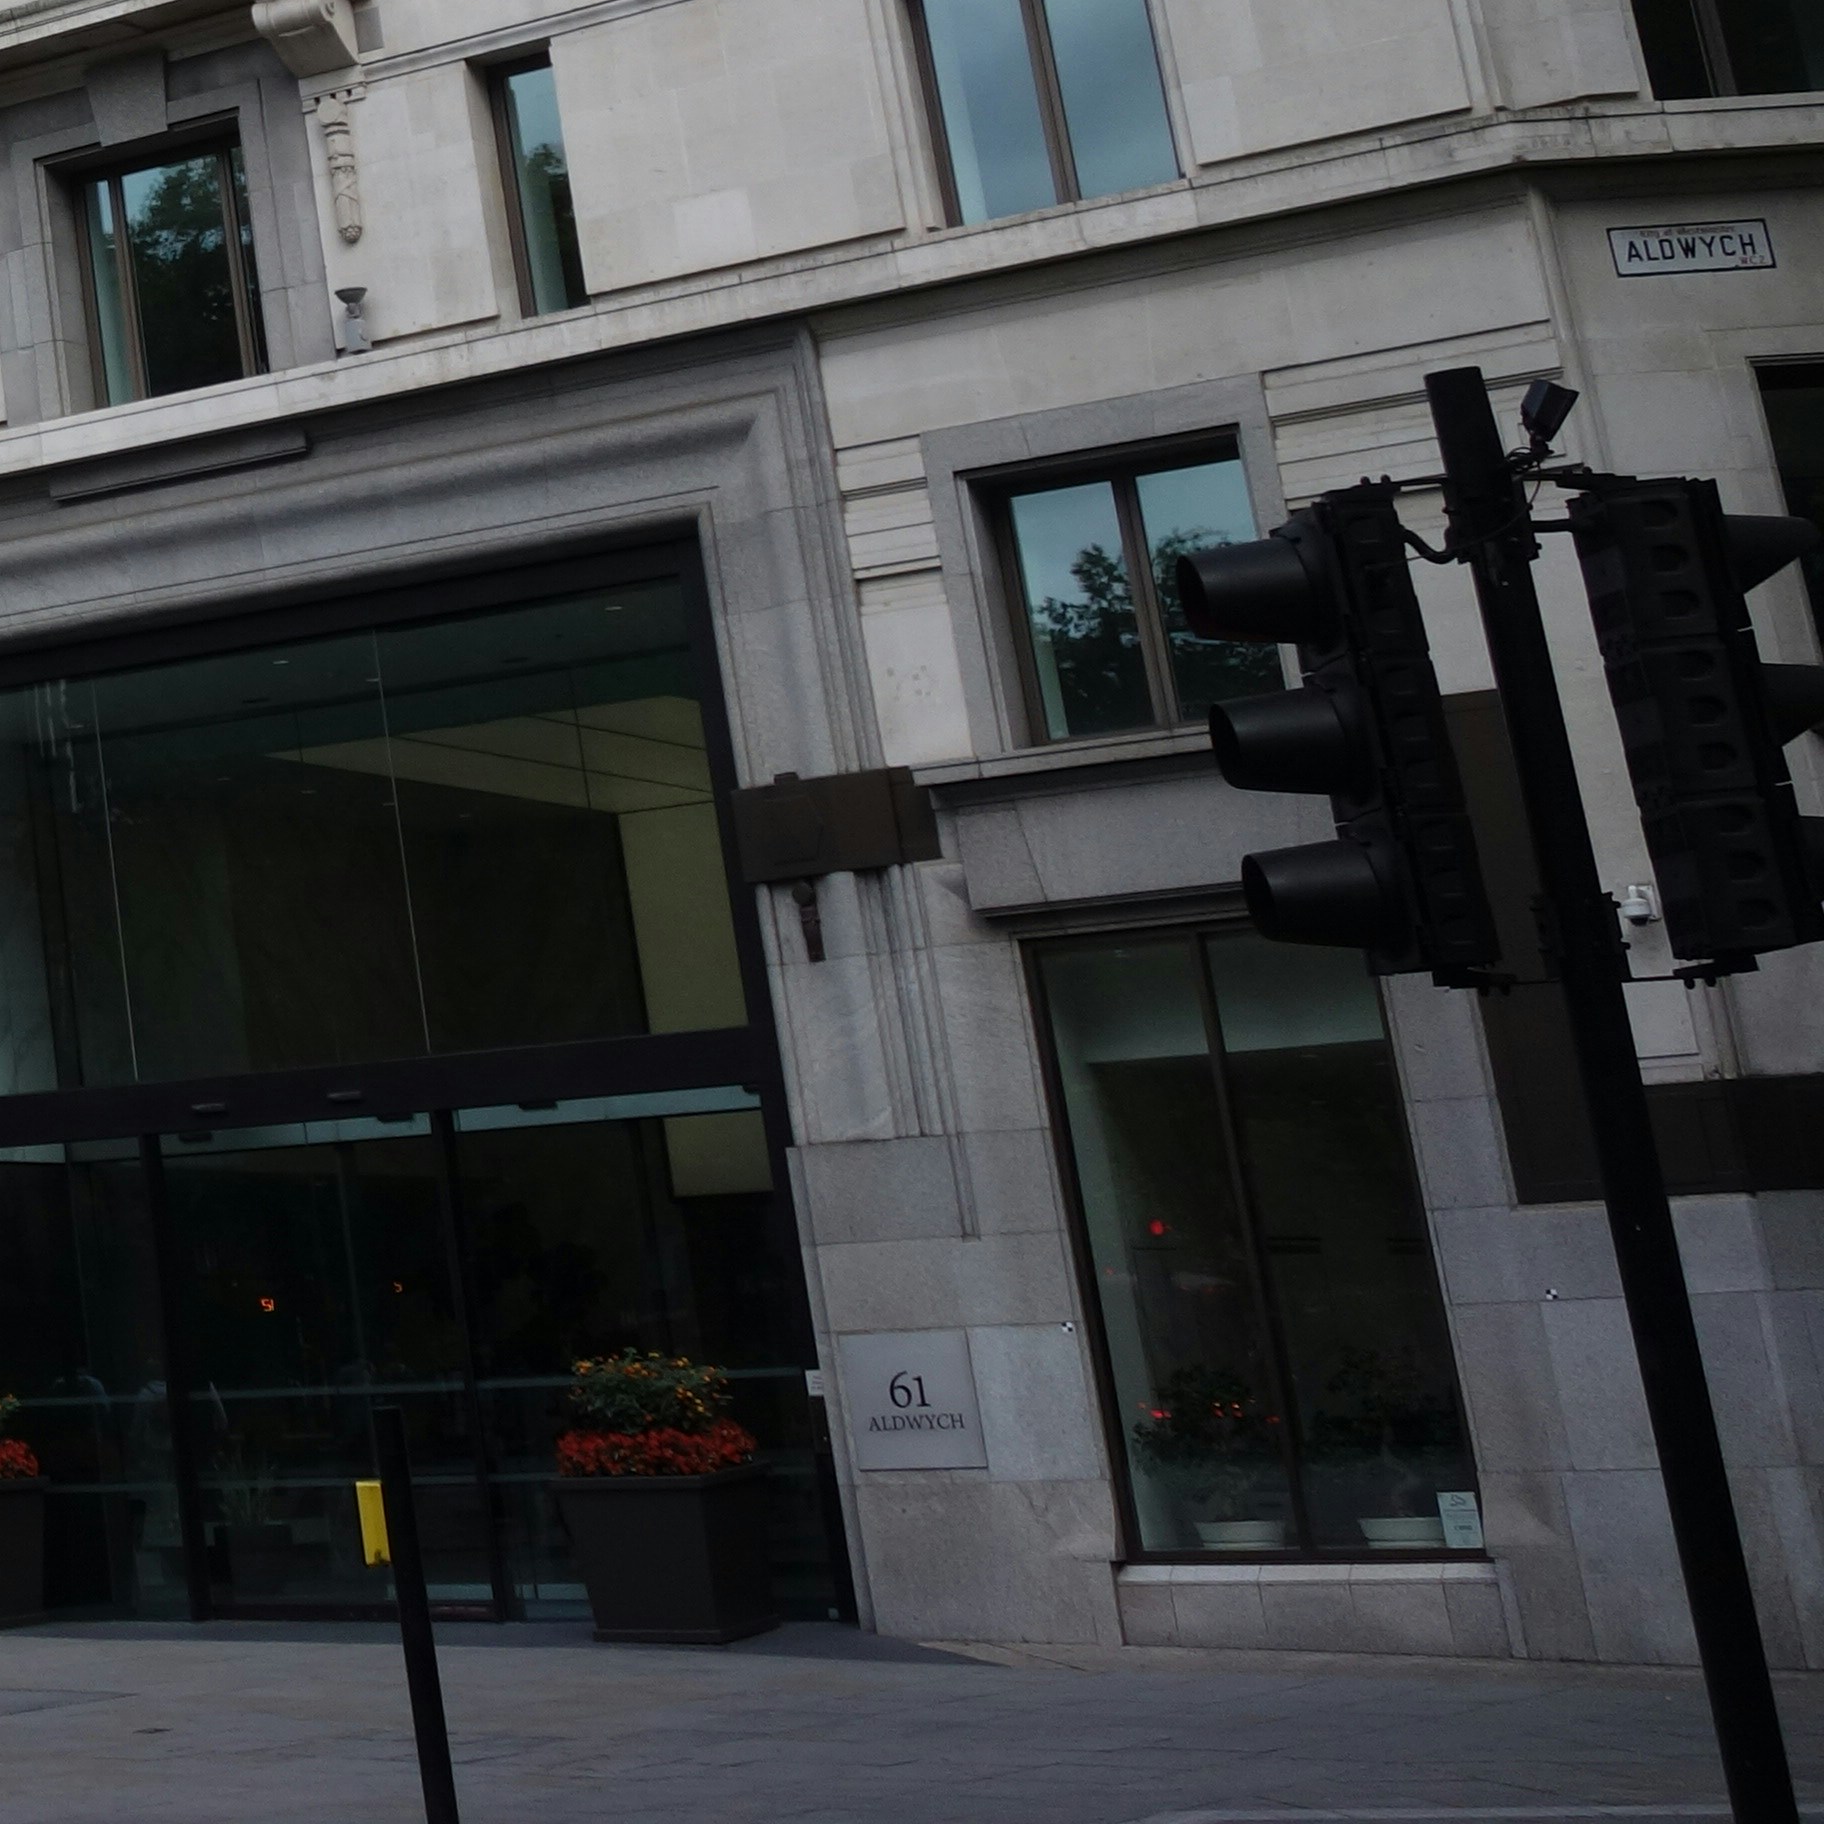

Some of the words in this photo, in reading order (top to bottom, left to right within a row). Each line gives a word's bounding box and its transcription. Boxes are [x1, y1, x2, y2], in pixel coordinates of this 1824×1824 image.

[1627, 233, 1757, 263] ALDWYCH
[888, 1370, 932, 1409] 61
[868, 1413, 966, 1432] ALDWYCH
